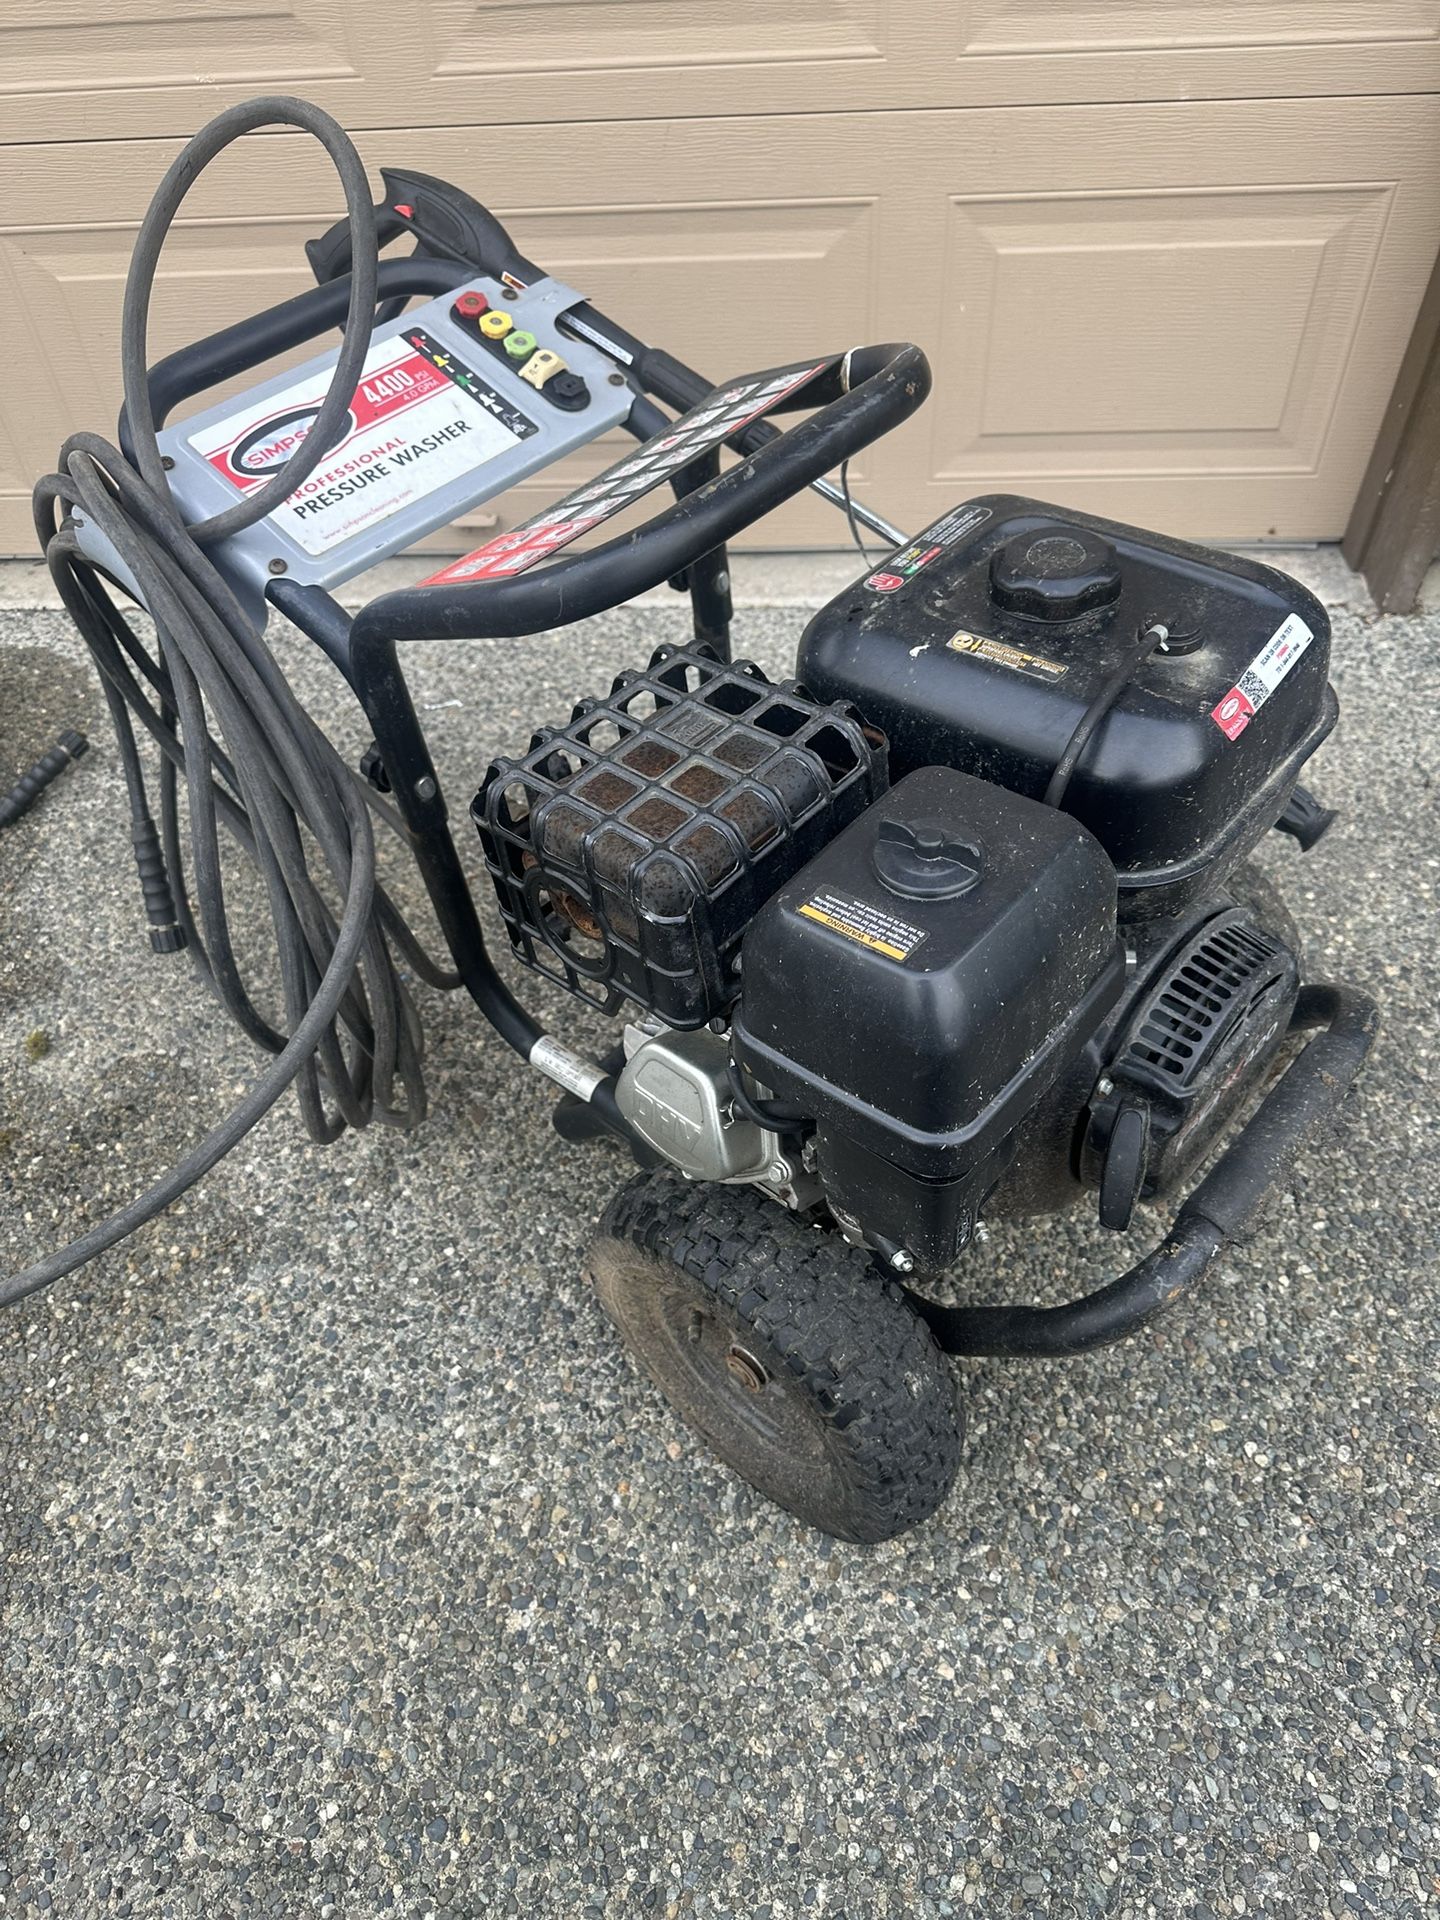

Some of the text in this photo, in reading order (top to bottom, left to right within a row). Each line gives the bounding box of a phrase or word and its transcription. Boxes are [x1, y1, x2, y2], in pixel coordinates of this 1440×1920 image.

[362, 369, 430, 404] 4400 PSI
[403, 377, 441, 403] 4.0 GPM
[247, 425, 315, 466] SIMPS
[293, 419, 472, 520] PRESSURE WASHER
[826, 918, 865, 939] WARNING
[865, 928, 881, 939] highly
[887, 939, 910, 953] Gasoline
